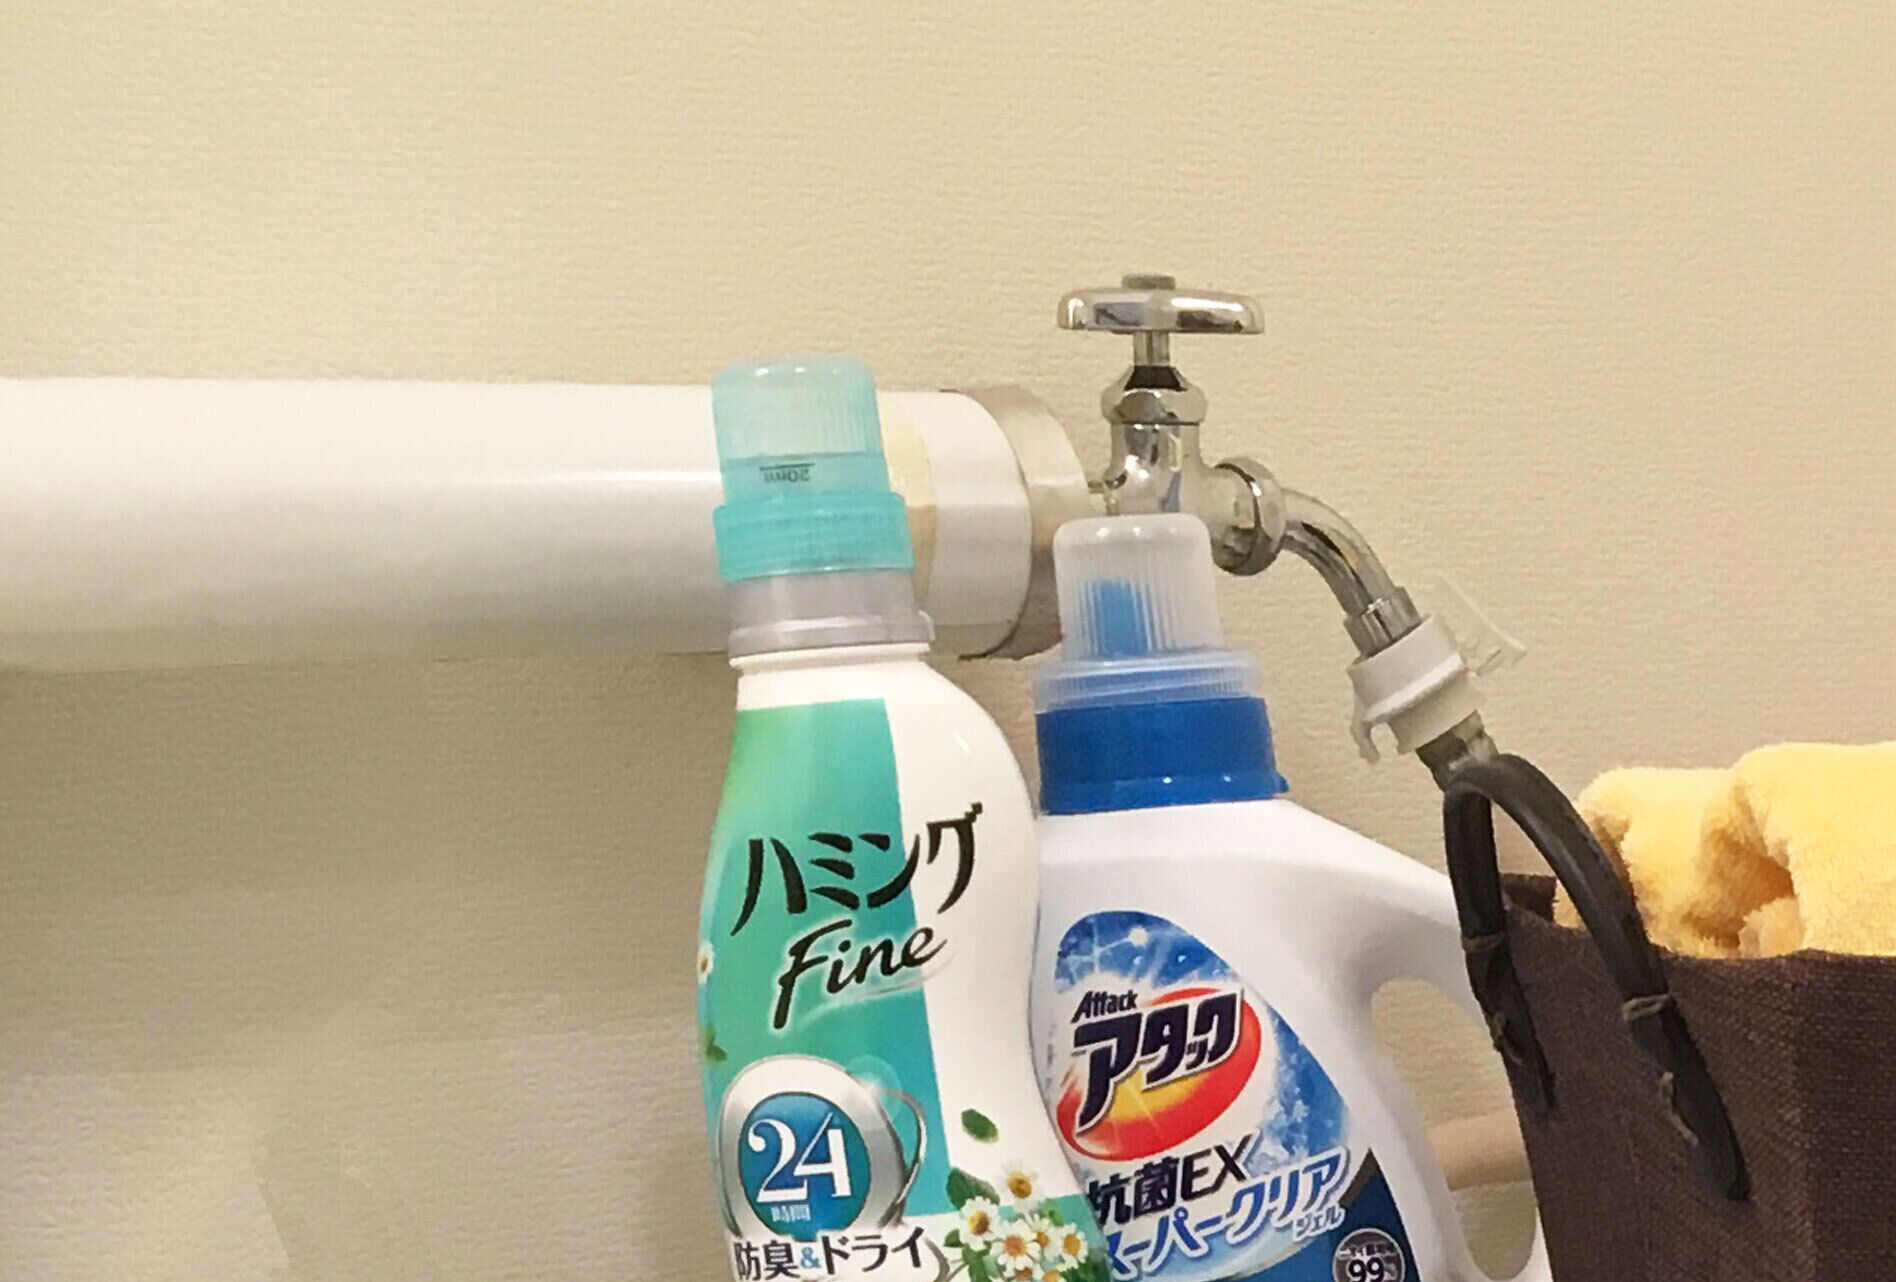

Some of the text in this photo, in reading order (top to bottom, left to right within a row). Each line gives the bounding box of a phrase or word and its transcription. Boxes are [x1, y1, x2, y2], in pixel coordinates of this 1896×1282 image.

[730, 802, 983, 936] ハミング
[773, 919, 947, 1029] Fine
[1071, 989, 1139, 1024] Attack
[1073, 993, 1238, 1128] アタック
[748, 1112, 852, 1204] 24
[1088, 1135, 1253, 1225] 抗菌EX
[732, 1226, 926, 1282] 防臭&ドライ
[1295, 1207, 1343, 1237] ジェル
